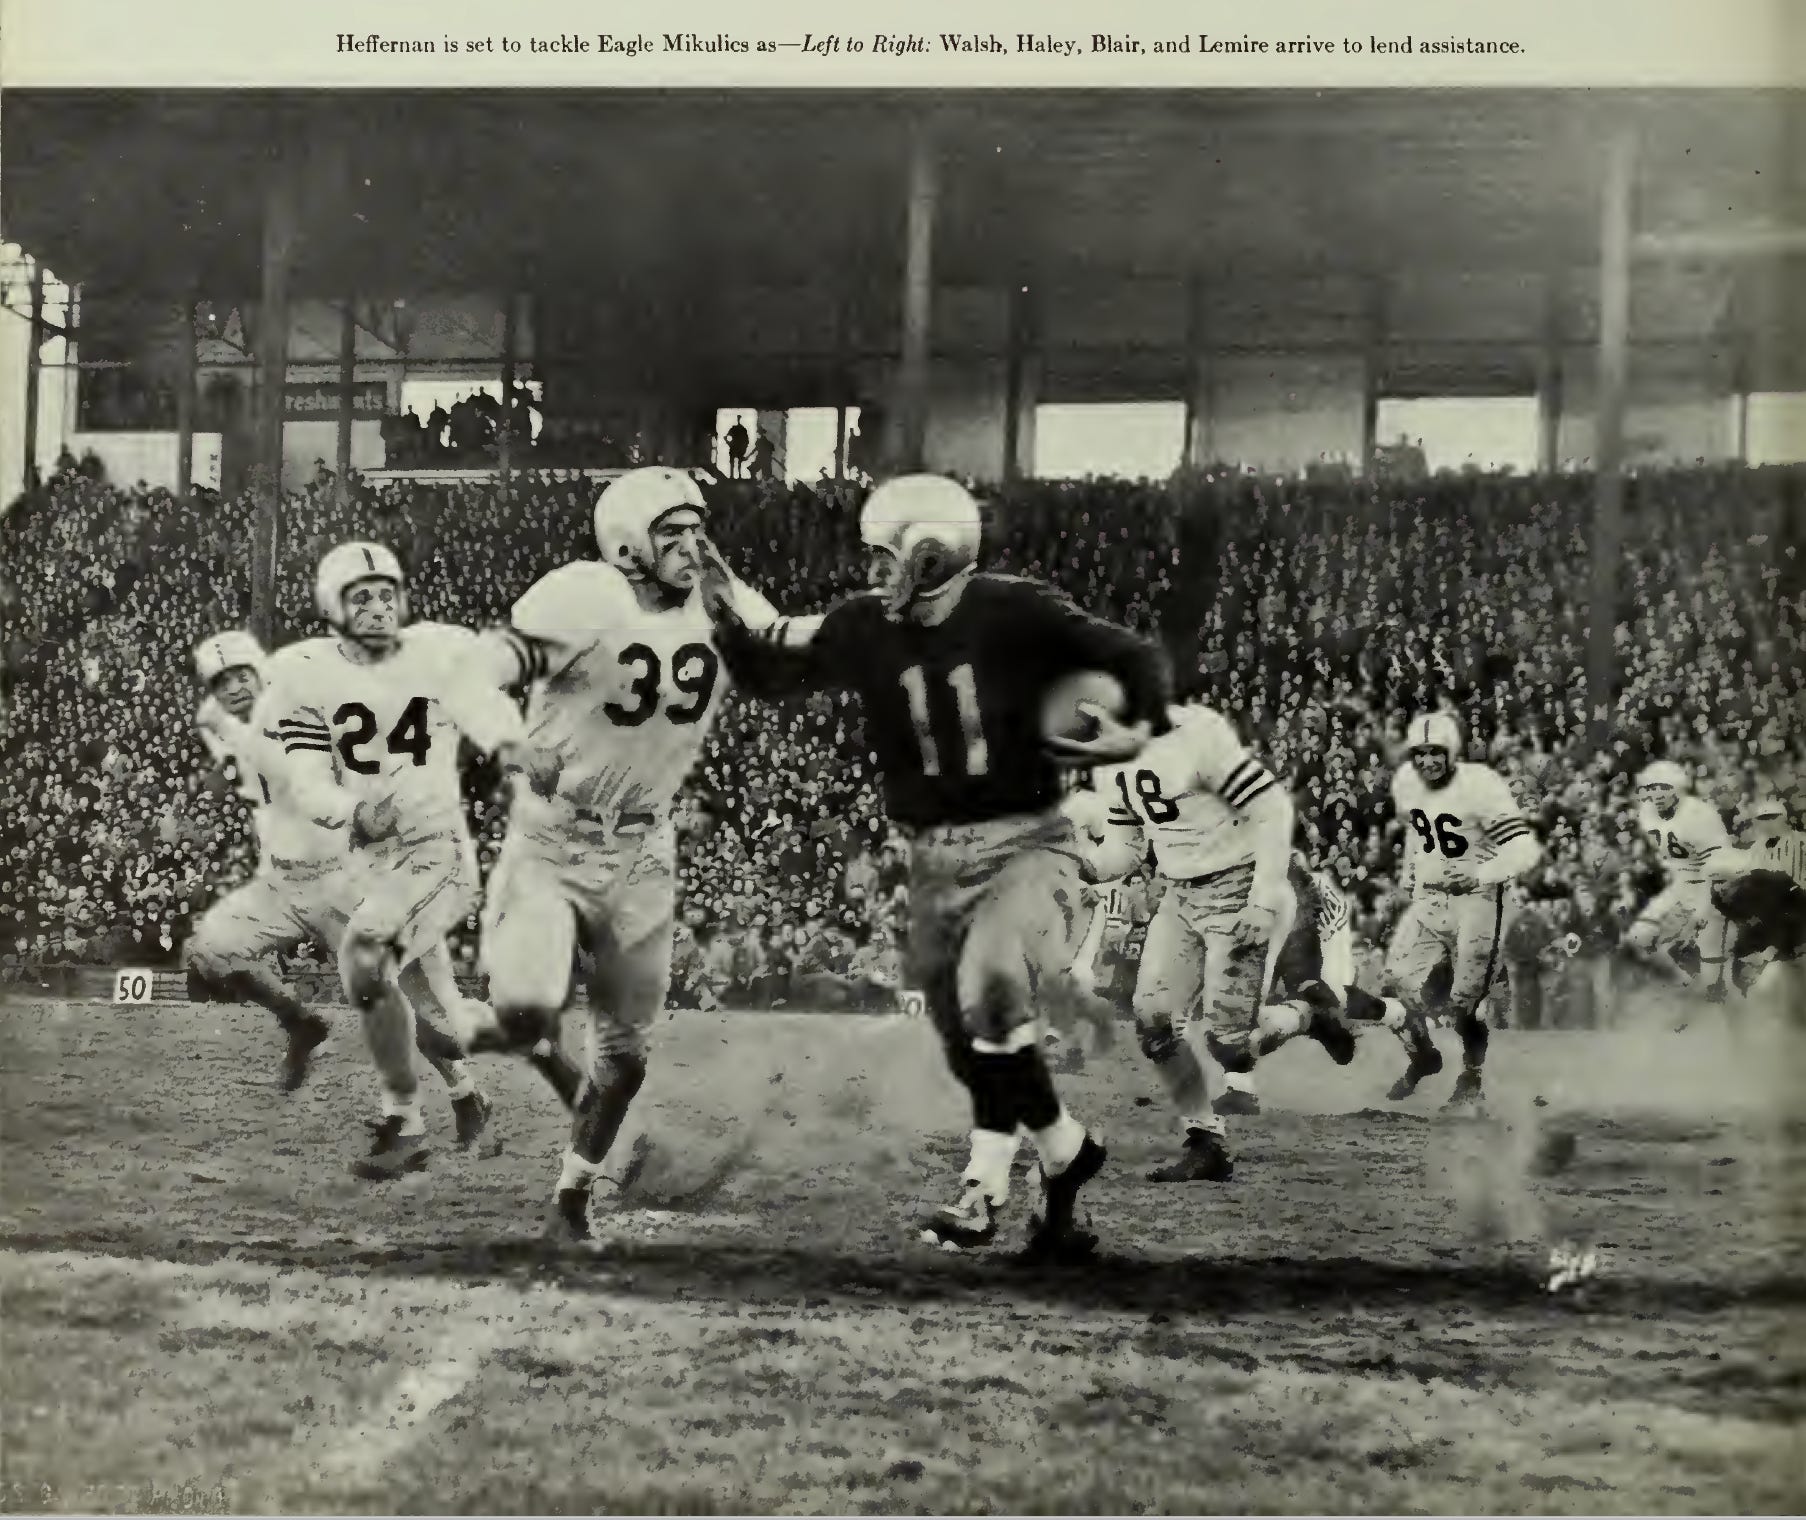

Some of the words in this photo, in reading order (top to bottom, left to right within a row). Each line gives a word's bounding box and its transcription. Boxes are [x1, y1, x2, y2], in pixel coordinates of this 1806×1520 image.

[603, 643, 719, 726] 39
[899, 663, 989, 776] 11
[332, 697, 432, 775] 24
[119, 975, 147, 1001] 50
